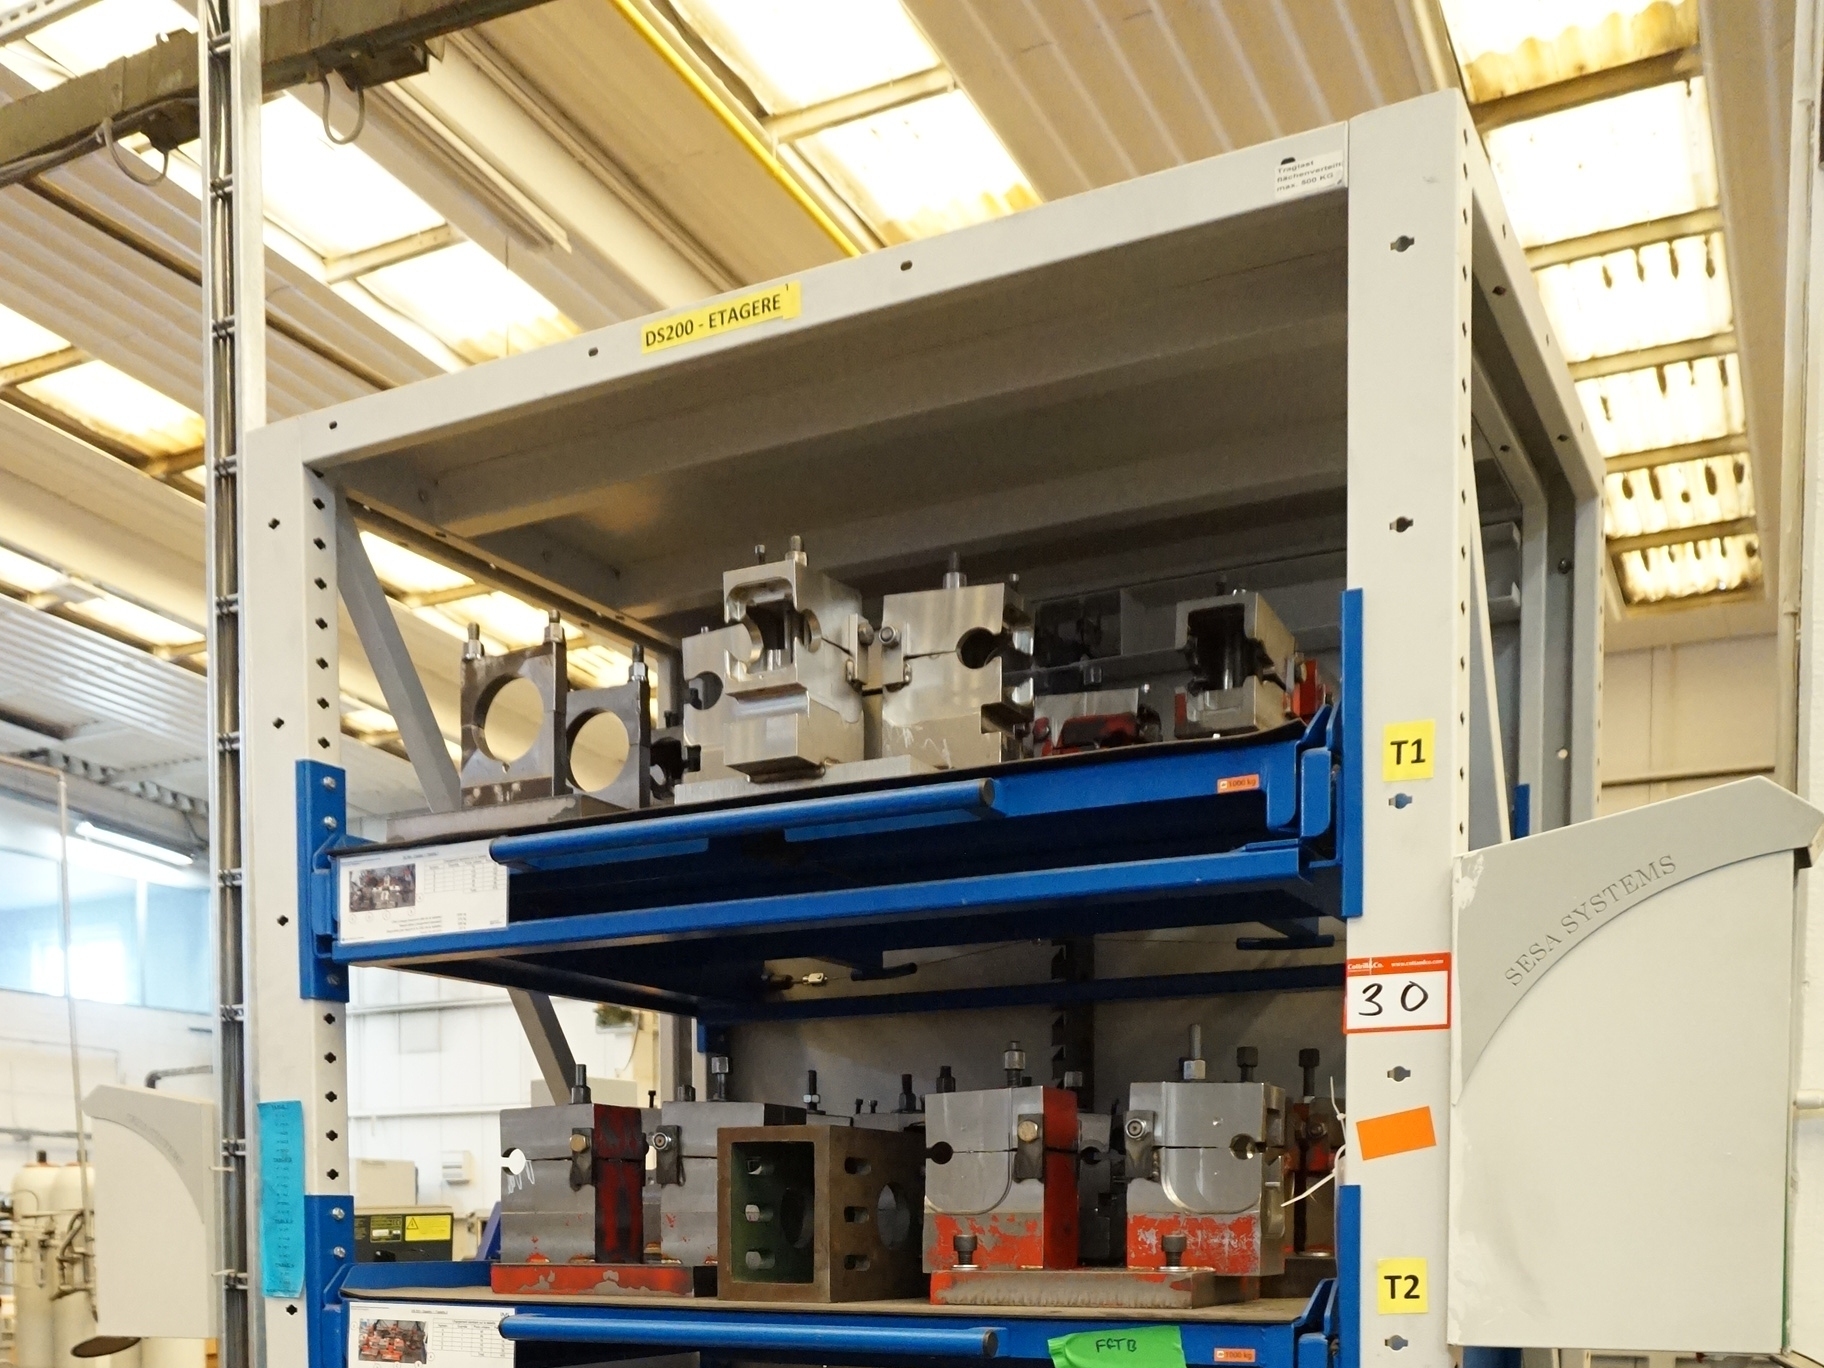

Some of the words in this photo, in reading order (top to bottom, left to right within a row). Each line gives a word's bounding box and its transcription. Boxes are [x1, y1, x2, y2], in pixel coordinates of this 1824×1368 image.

[1320, 172, 1334, 180] KG
[645, 319, 694, 347] DS200
[709, 293, 781, 329] ETAGERE
[1390, 738, 1426, 765] T1
[1504, 934, 1562, 987] SESA
[1561, 855, 1677, 934] SYSTEMS
[1358, 980, 1429, 1017] 30
[1383, 1274, 1420, 1300] T2
